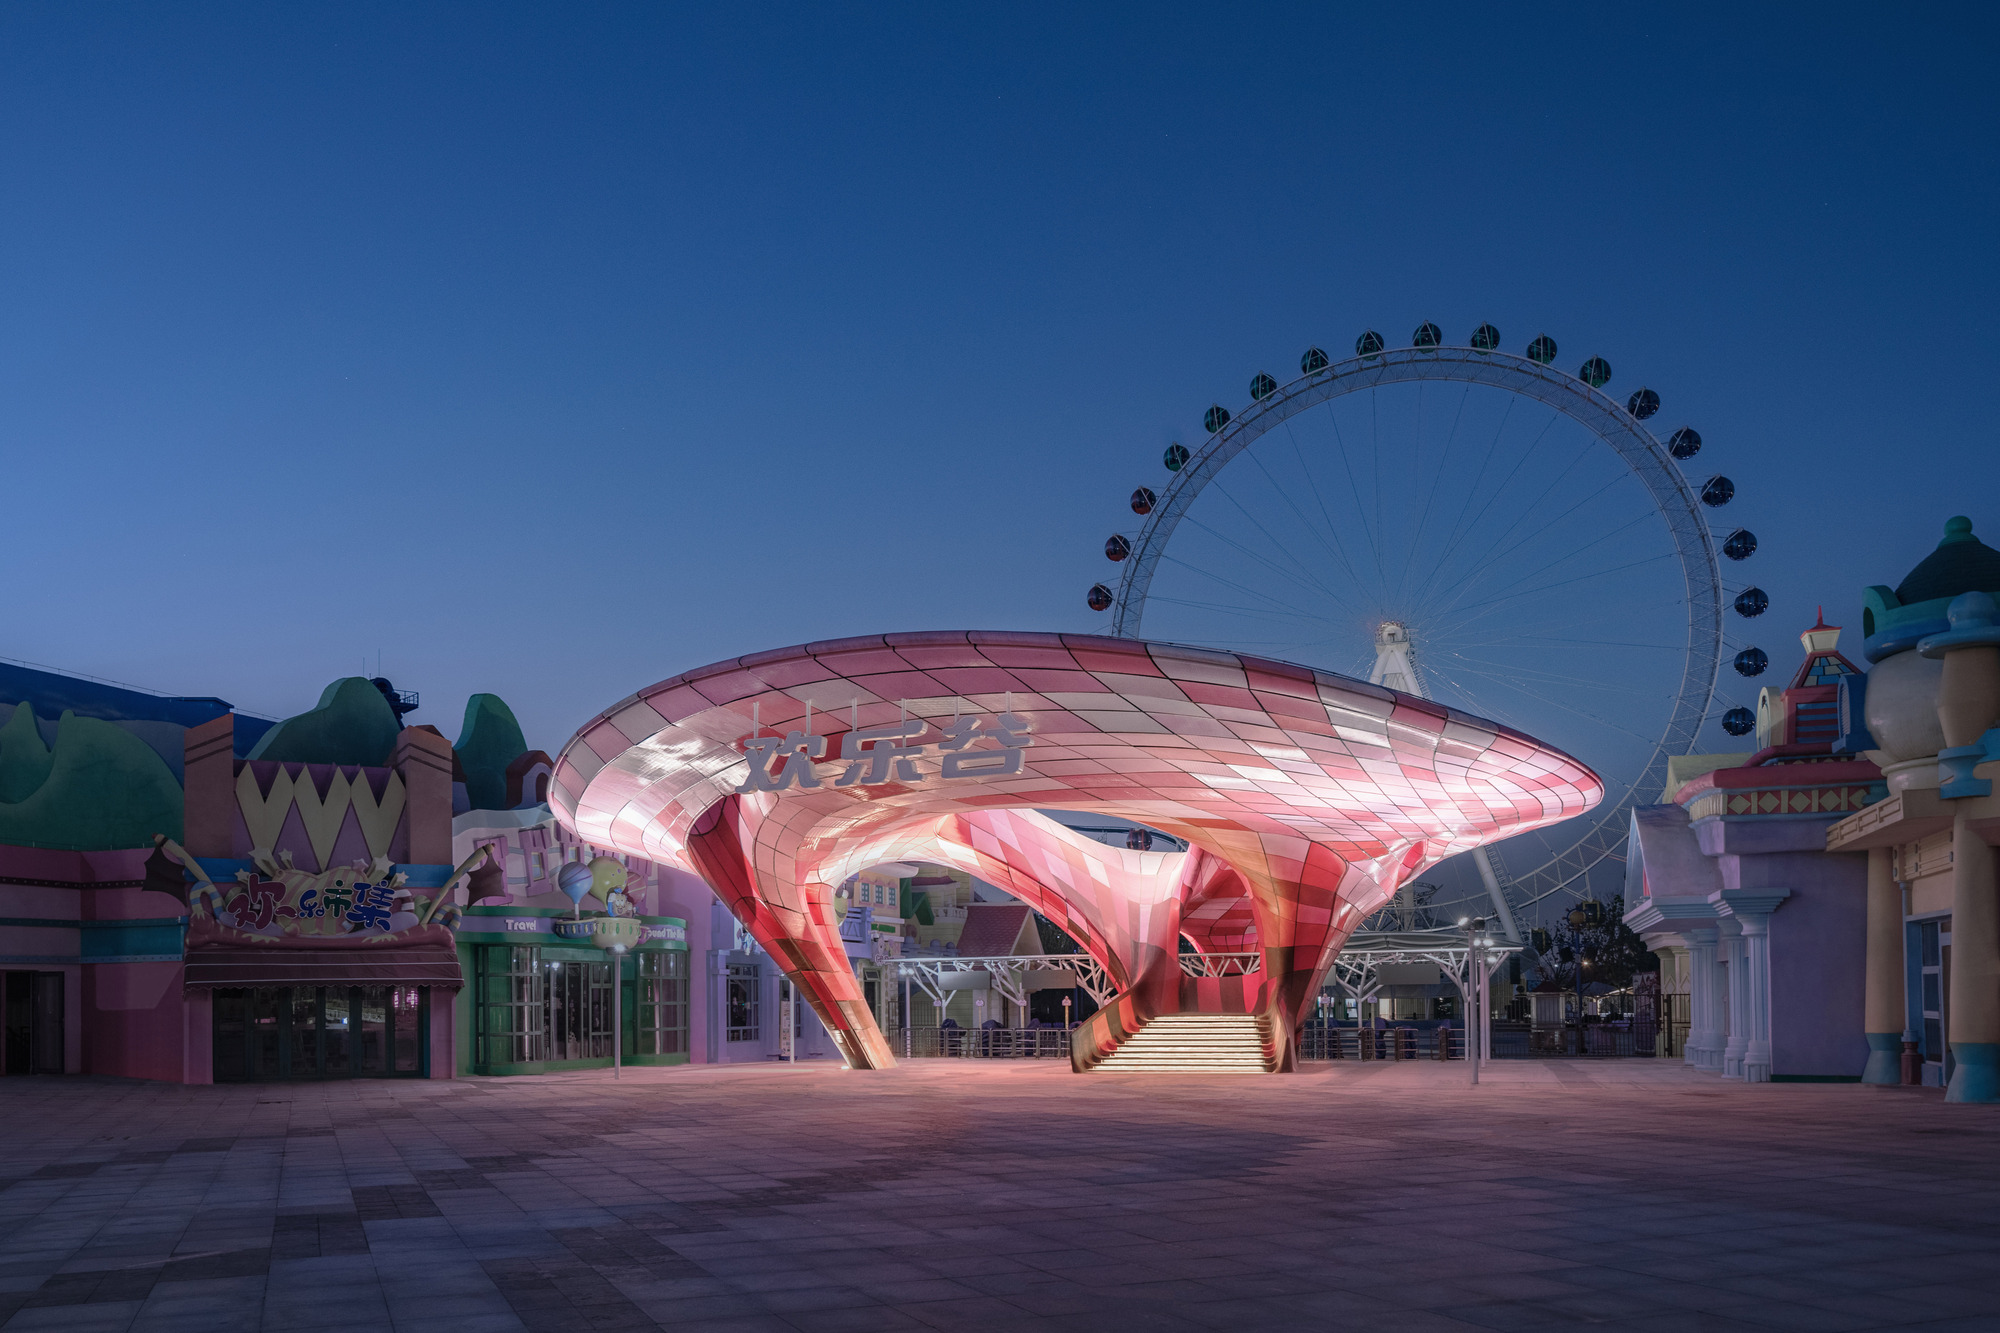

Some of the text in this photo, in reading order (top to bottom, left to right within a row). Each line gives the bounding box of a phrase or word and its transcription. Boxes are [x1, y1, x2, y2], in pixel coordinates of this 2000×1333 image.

[735, 712, 1034, 792] 欢乐谷
[227, 873, 396, 932] 欢乐市集
[505, 919, 537, 931] Travel
